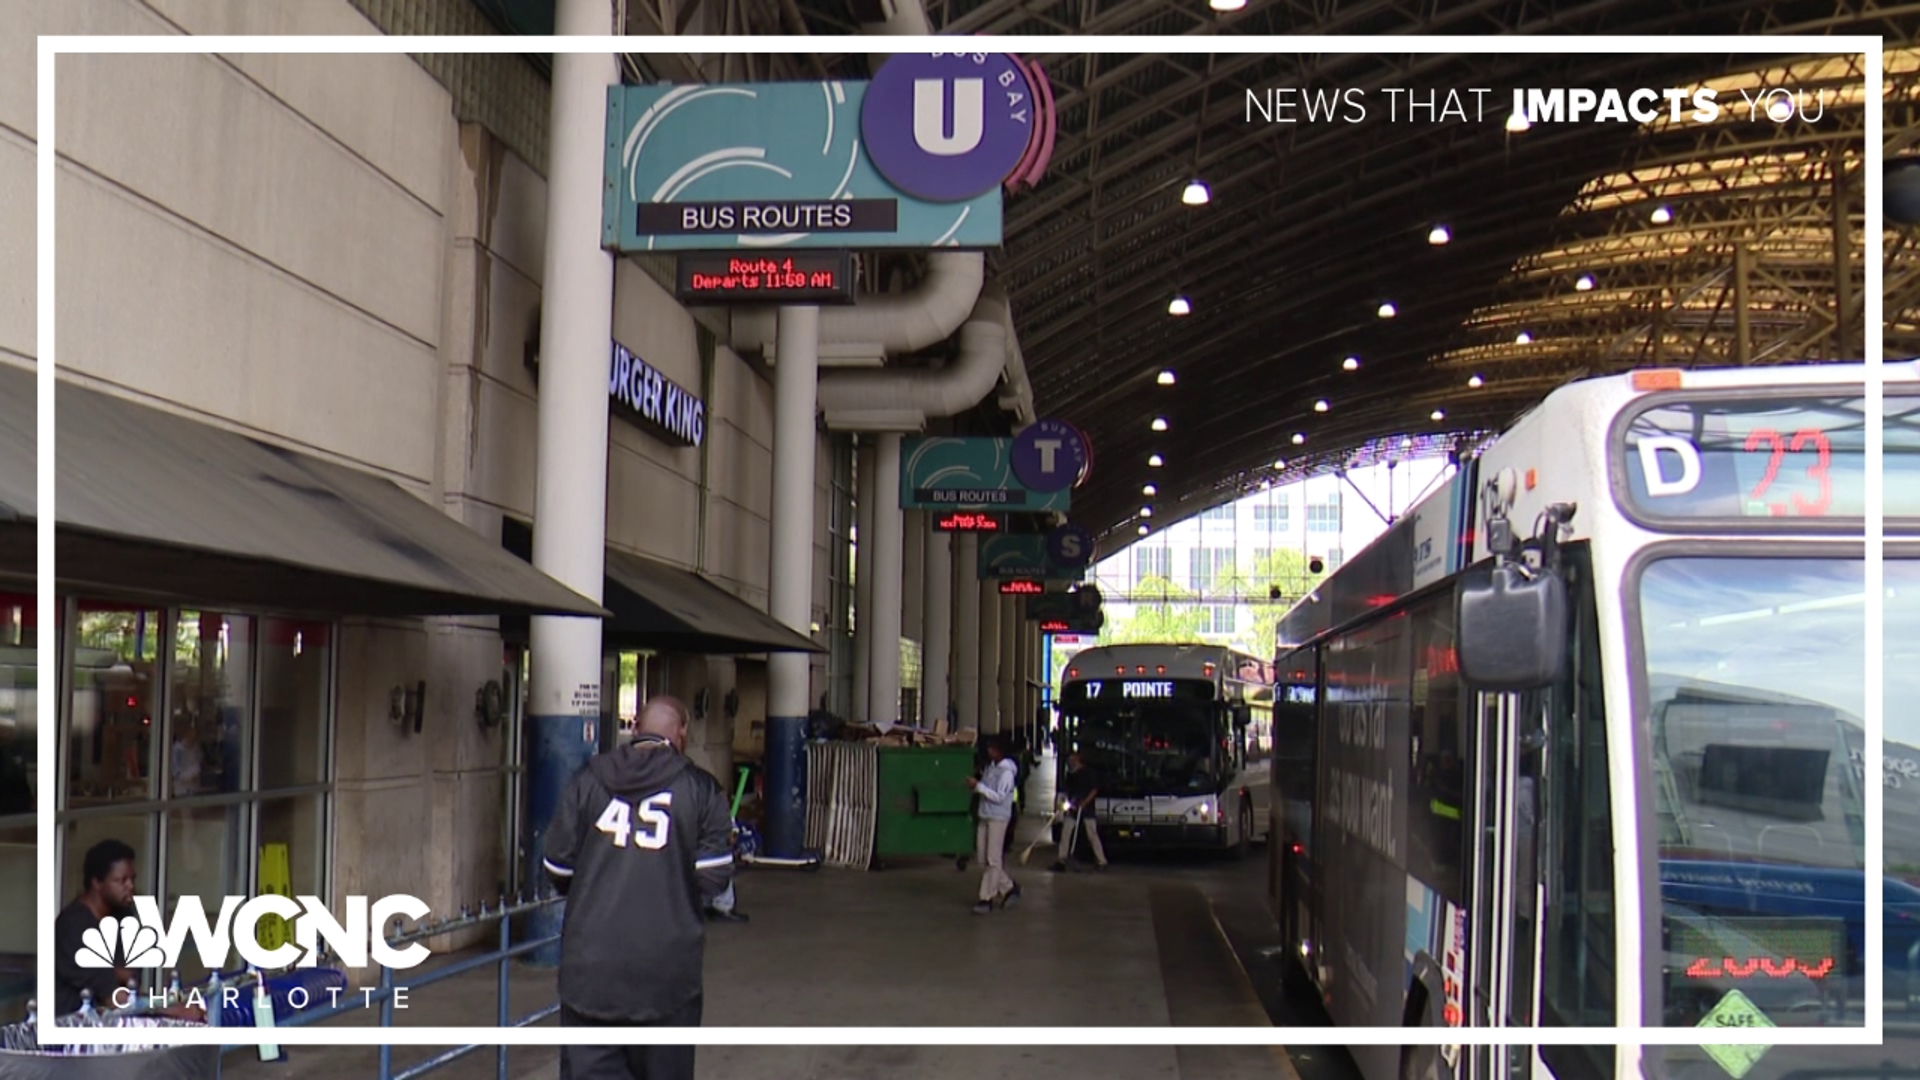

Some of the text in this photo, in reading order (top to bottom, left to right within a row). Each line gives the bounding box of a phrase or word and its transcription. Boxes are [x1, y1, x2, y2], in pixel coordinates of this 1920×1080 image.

[999, 69, 1027, 124] BAY
[914, 77, 984, 156] U
[683, 204, 851, 229] BUS ROUTES
[730, 258, 793, 273] Route 4
[693, 274, 759, 289] Departs
[811, 272, 832, 287] AM
[665, 381, 703, 447] KING
[1041, 423, 1067, 439] BUS
[1034, 438, 1062, 473] T
[1638, 436, 1703, 497] D
[933, 490, 1007, 502] BUS ROUTES
[1061, 534, 1081, 558] S
[1085, 681, 1173, 699] 17 POINTE
[595, 791, 673, 850] 45
[1715, 1014, 1756, 1027] SAFE
